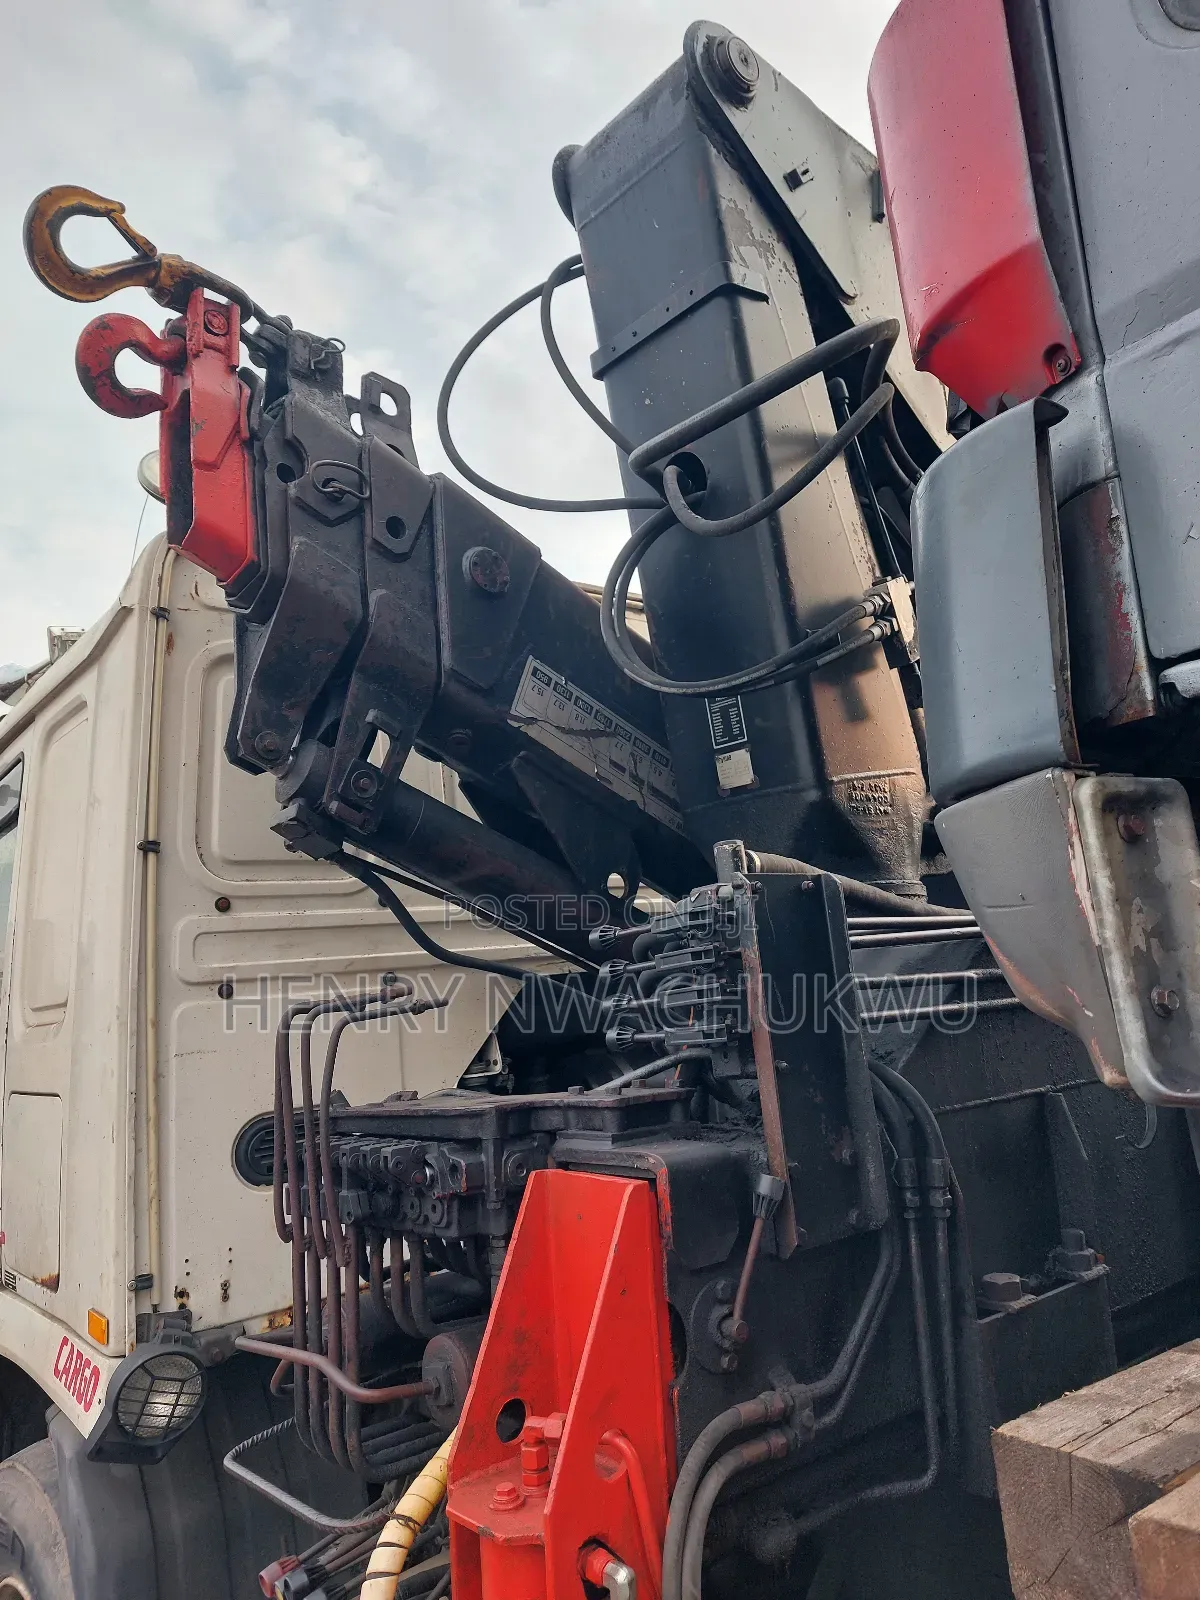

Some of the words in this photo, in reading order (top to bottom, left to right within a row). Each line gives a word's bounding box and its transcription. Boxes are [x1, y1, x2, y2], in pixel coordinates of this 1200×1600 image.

[536, 670, 549, 684] 950
[531, 684, 544, 697] 15.7
[556, 685, 570, 699] 1130
[553, 699, 565, 711] 13.7
[53, 1335, 101, 1414] CARGO
